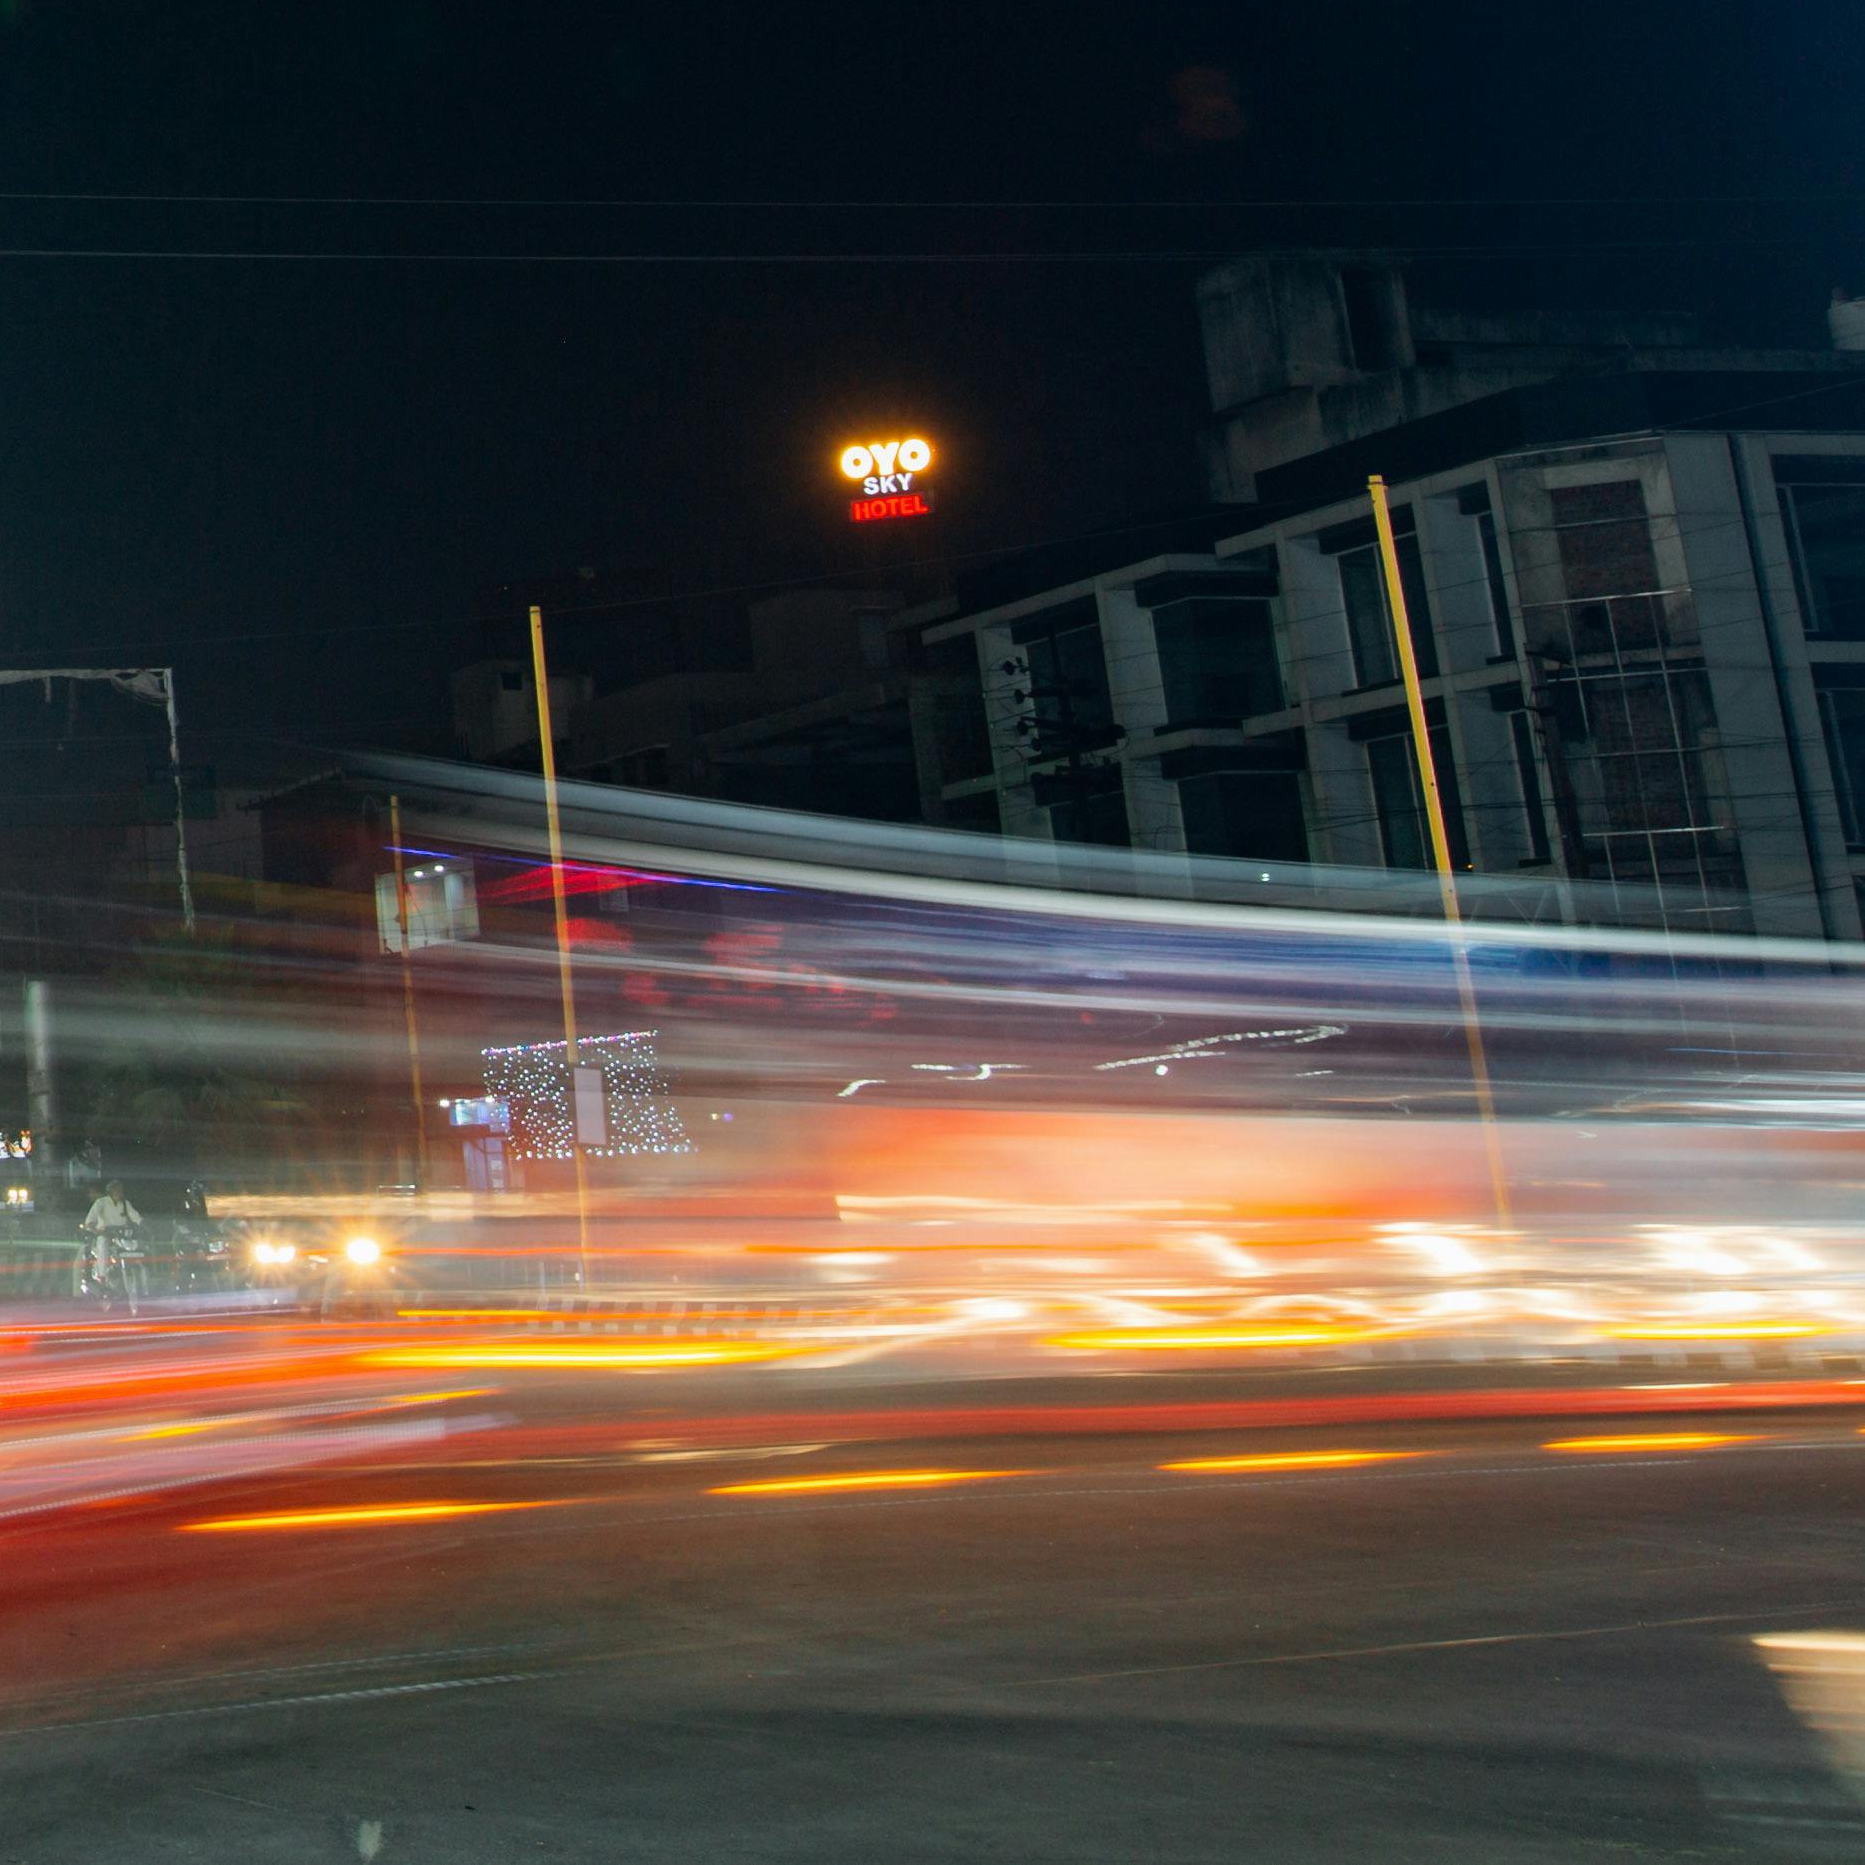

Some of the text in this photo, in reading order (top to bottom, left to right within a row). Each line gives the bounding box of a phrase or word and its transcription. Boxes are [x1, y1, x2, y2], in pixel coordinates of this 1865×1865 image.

[841, 438, 931, 479] OYO
[863, 472, 913, 495] SKY
[852, 495, 930, 521] HOTEL
